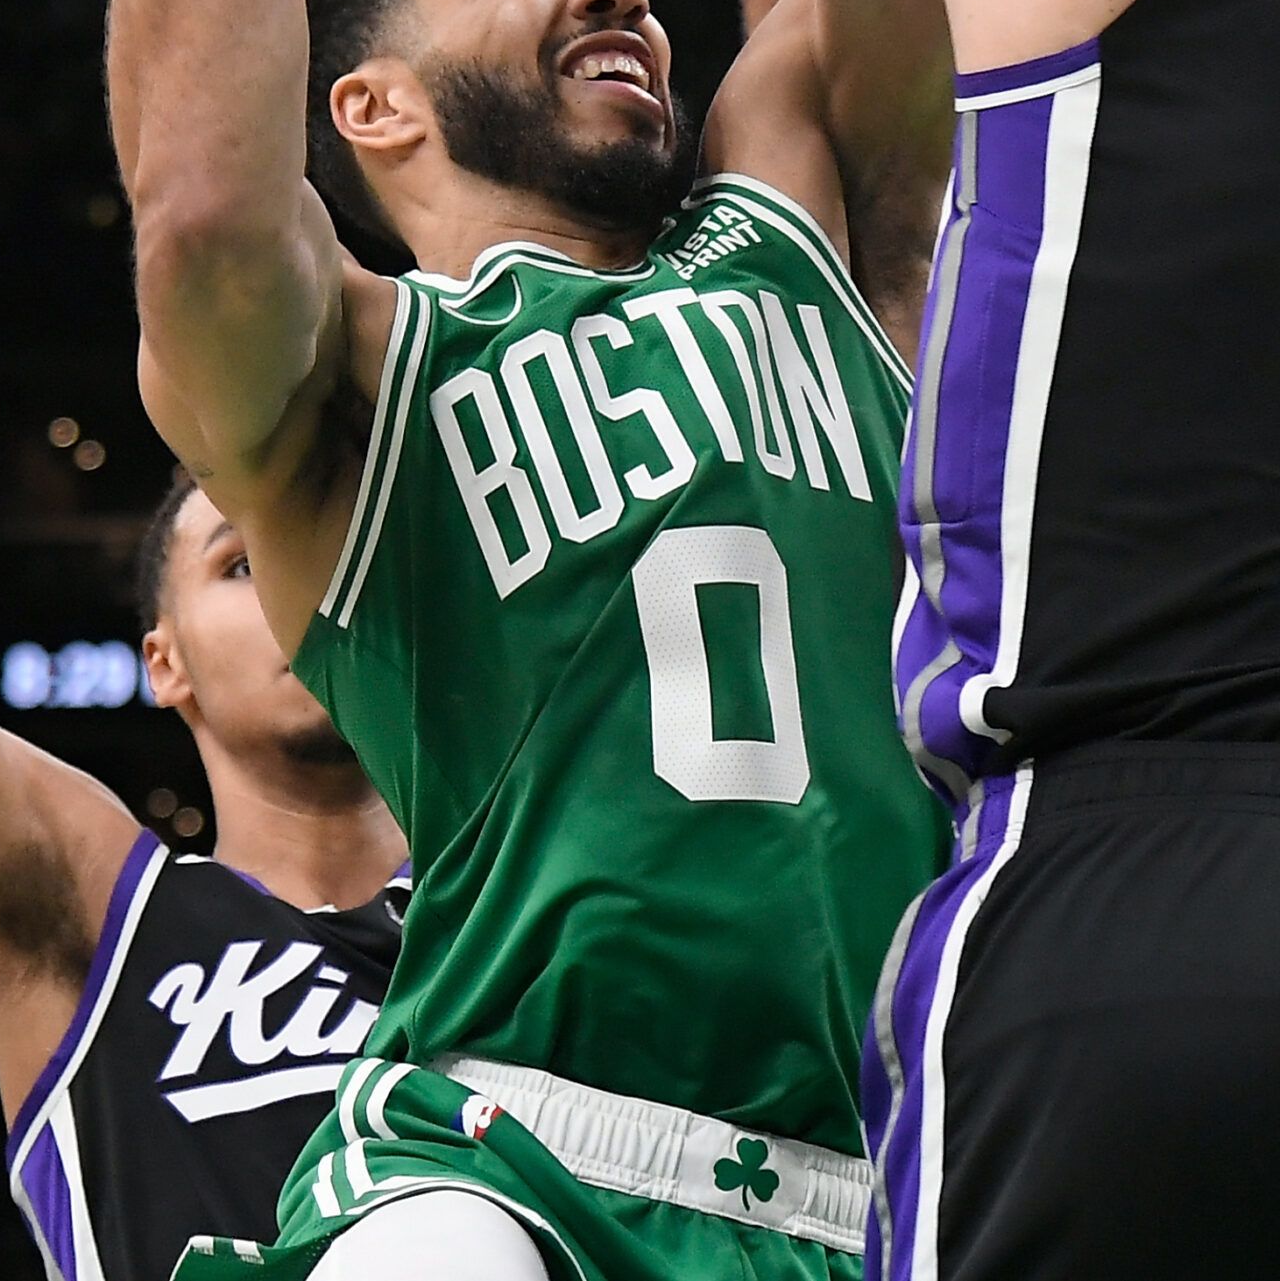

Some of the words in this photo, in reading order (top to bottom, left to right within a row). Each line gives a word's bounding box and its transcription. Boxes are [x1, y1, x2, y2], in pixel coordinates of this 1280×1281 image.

[656, 205, 749, 271] VISTA
[677, 220, 763, 281] PRINT
[429, 286, 874, 601] BOSTON
[631, 525, 812, 806] 0
